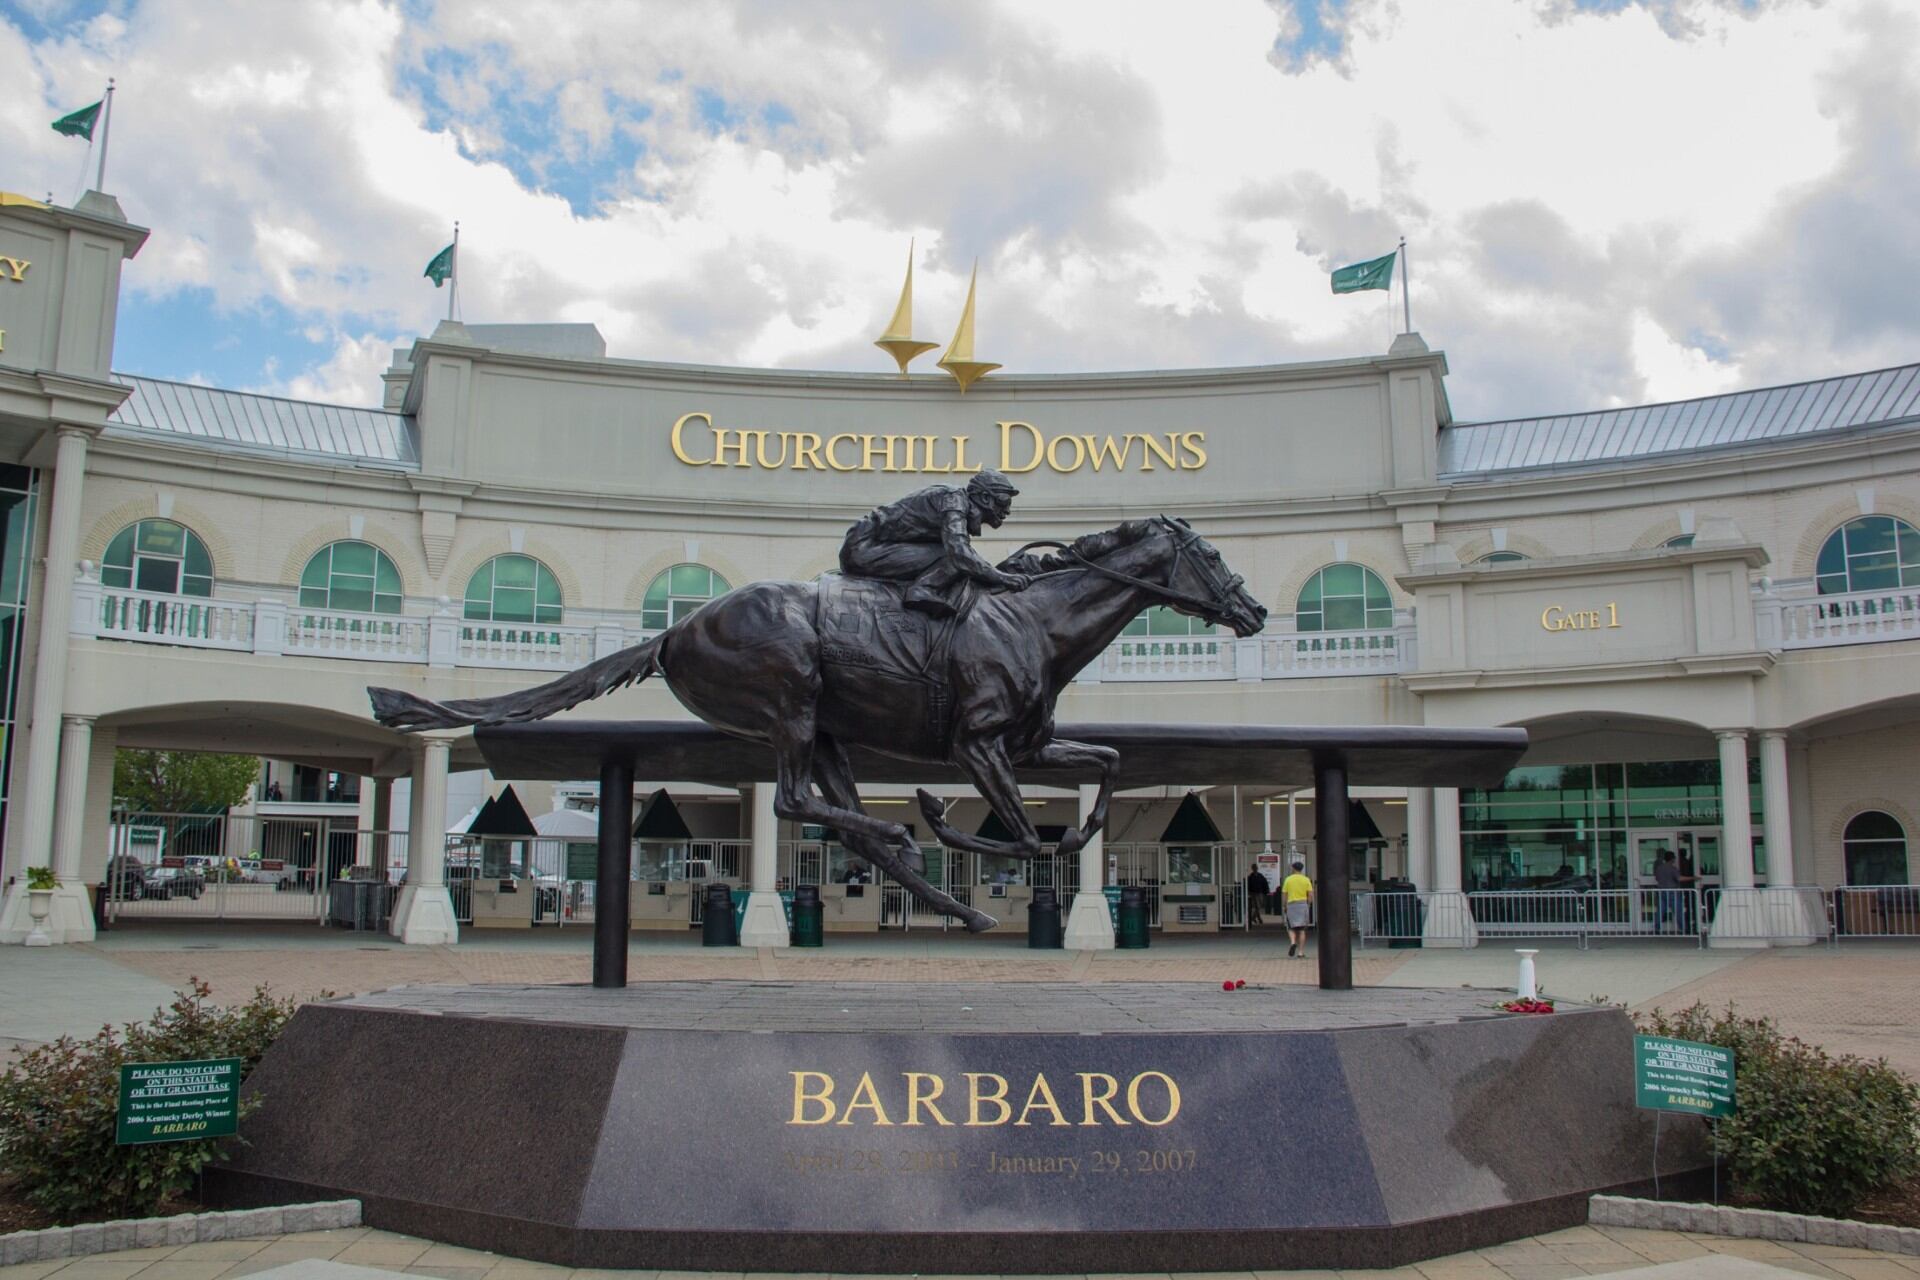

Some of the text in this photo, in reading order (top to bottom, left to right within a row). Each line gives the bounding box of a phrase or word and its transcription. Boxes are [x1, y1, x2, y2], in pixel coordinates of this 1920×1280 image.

[671, 412, 1208, 474] CHURCHILL DOWNS
[1542, 601, 1623, 632] GATE 1
[1655, 808, 1703, 819] GENERAL
[1644, 1042, 1673, 1051] PLEASE
[1688, 1047, 1702, 1056] NOT
[1704, 1050, 1727, 1060] CLIMB
[1672, 1053, 1689, 1062] THIS
[1690, 1056, 1716, 1067] STATUE
[132, 1069, 166, 1077] PLEASE
[203, 1065, 231, 1073] CLIMB
[1660, 1060, 1674, 1068] THE
[1676, 1062, 1708, 1074] GRANITE
[1710, 1067, 1728, 1077] BASE
[163, 1077, 182, 1085] THIS
[185, 1075, 217, 1083] STATUE
[168, 1085, 207, 1094] GRANITE
[1661, 1085, 1691, 1094] Kentucky
[785, 1070, 1181, 1127] BARBARO
[1669, 1094, 1713, 1108] BARBARO
[146, 1114, 180, 1123] Kentucky
[182, 1112, 203, 1120] Derby
[153, 1121, 207, 1134] BARBARO
[986, 1151, 1081, 1178] January
[1092, 1150, 1129, 1176] 29,
[1138, 1150, 1197, 1173] 2007
